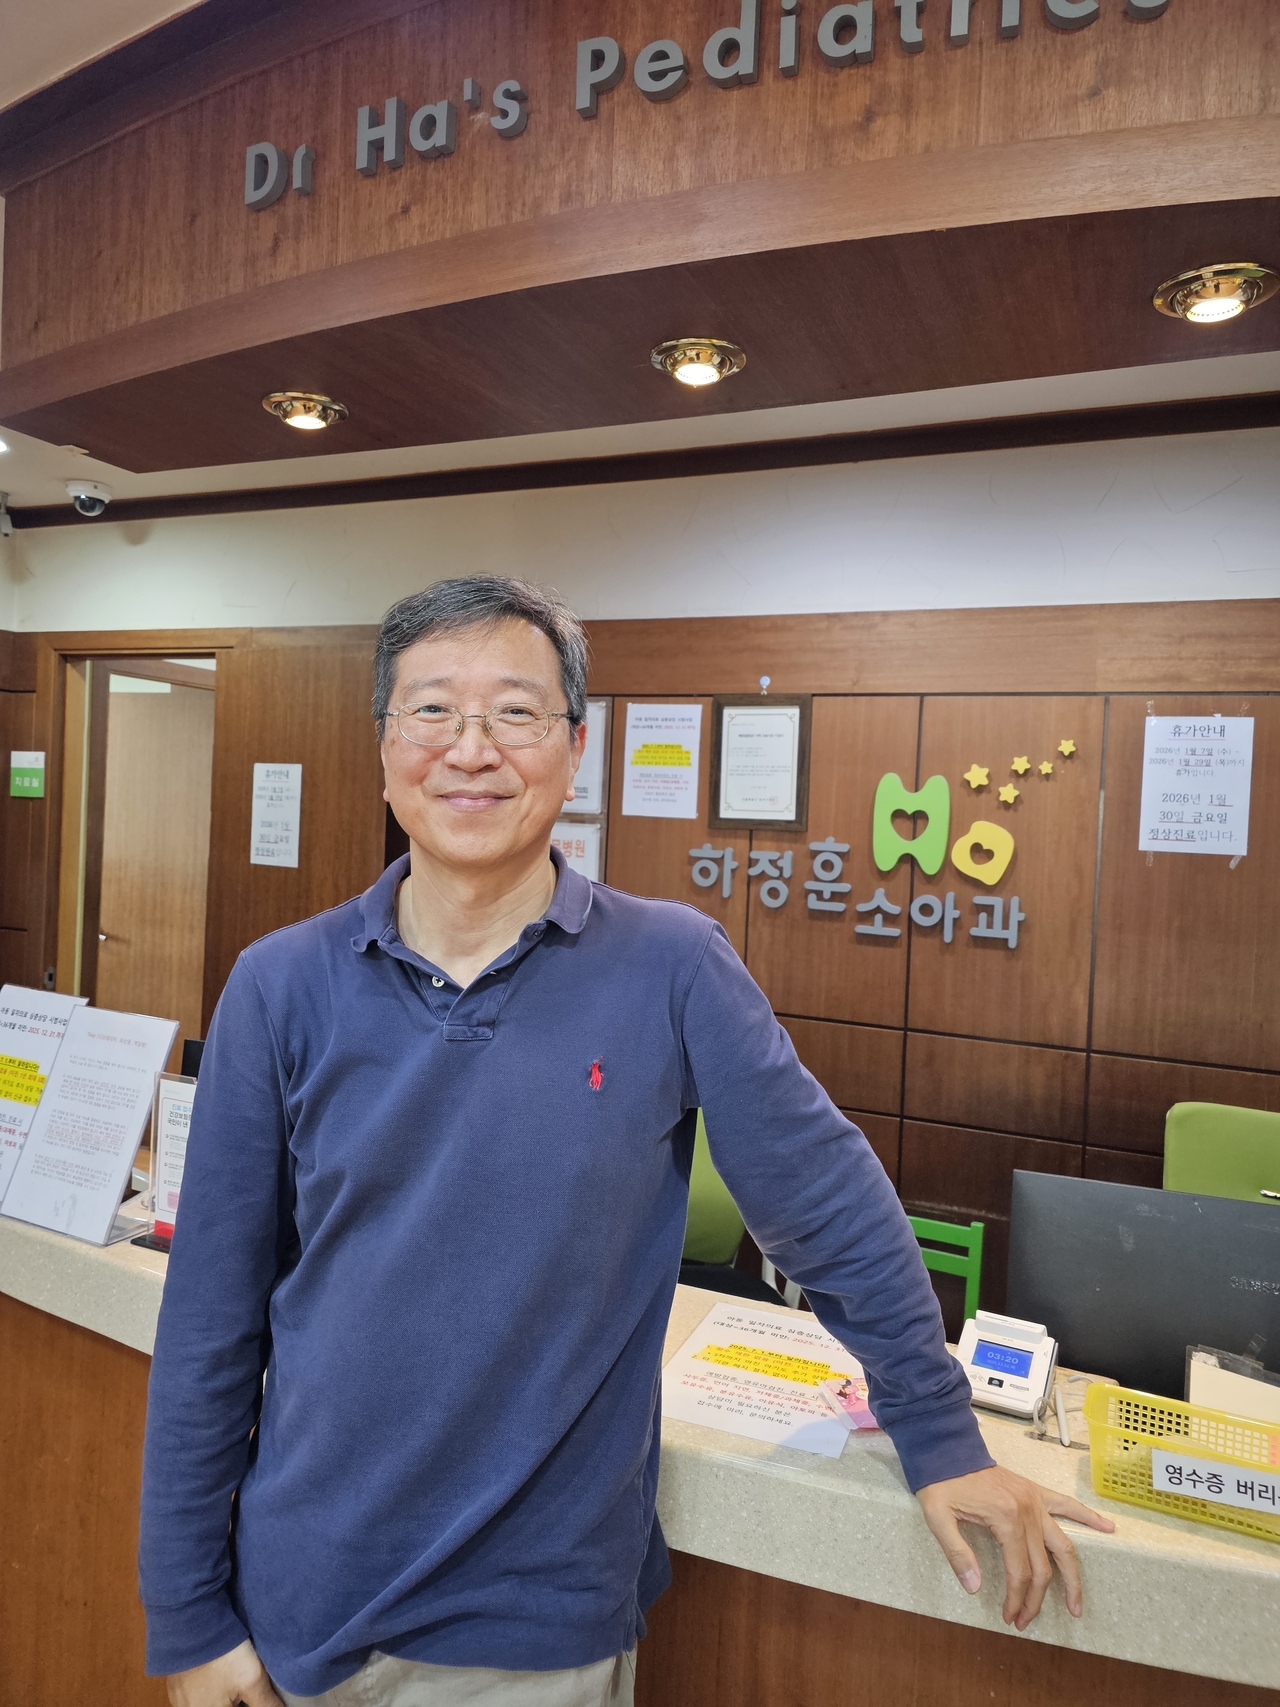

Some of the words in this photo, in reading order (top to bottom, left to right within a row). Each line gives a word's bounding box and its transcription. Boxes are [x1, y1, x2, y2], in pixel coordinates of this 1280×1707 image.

[244, 142, 315, 211] Dr
[355, 77, 528, 176] Ha's
[1170, 724, 1226, 738] 휴가안내
[1155, 747, 1180, 755] 2026년
[1149, 758, 1174, 766] 2026년
[1175, 768, 1217, 777] 휴가입니다.
[1162, 793, 1201, 805] 2026년
[1209, 794, 1227, 807] 1월
[1159, 810, 1184, 823] 30일
[1191, 811, 1228, 824] 금요일
[1149, 828, 1237, 842] 정상진료입니다.
[688, 836, 852, 912] 하정훈
[854, 887, 1026, 949] 소아과
[748, 1320, 782, 1331] 일차의료
[788, 1328, 822, 1340] 심층상담
[792, 1337, 815, 1346] 2025.
[987, 1351, 1019, 1365] 03:20
[708, 1394, 733, 1405] 상담이
[737, 1400, 771, 1413] 필요하신
[749, 1411, 794, 1428] 문의하세요.
[1165, 1464, 1225, 1494] 영수증
[1236, 1479, 1280, 1506] 버리
